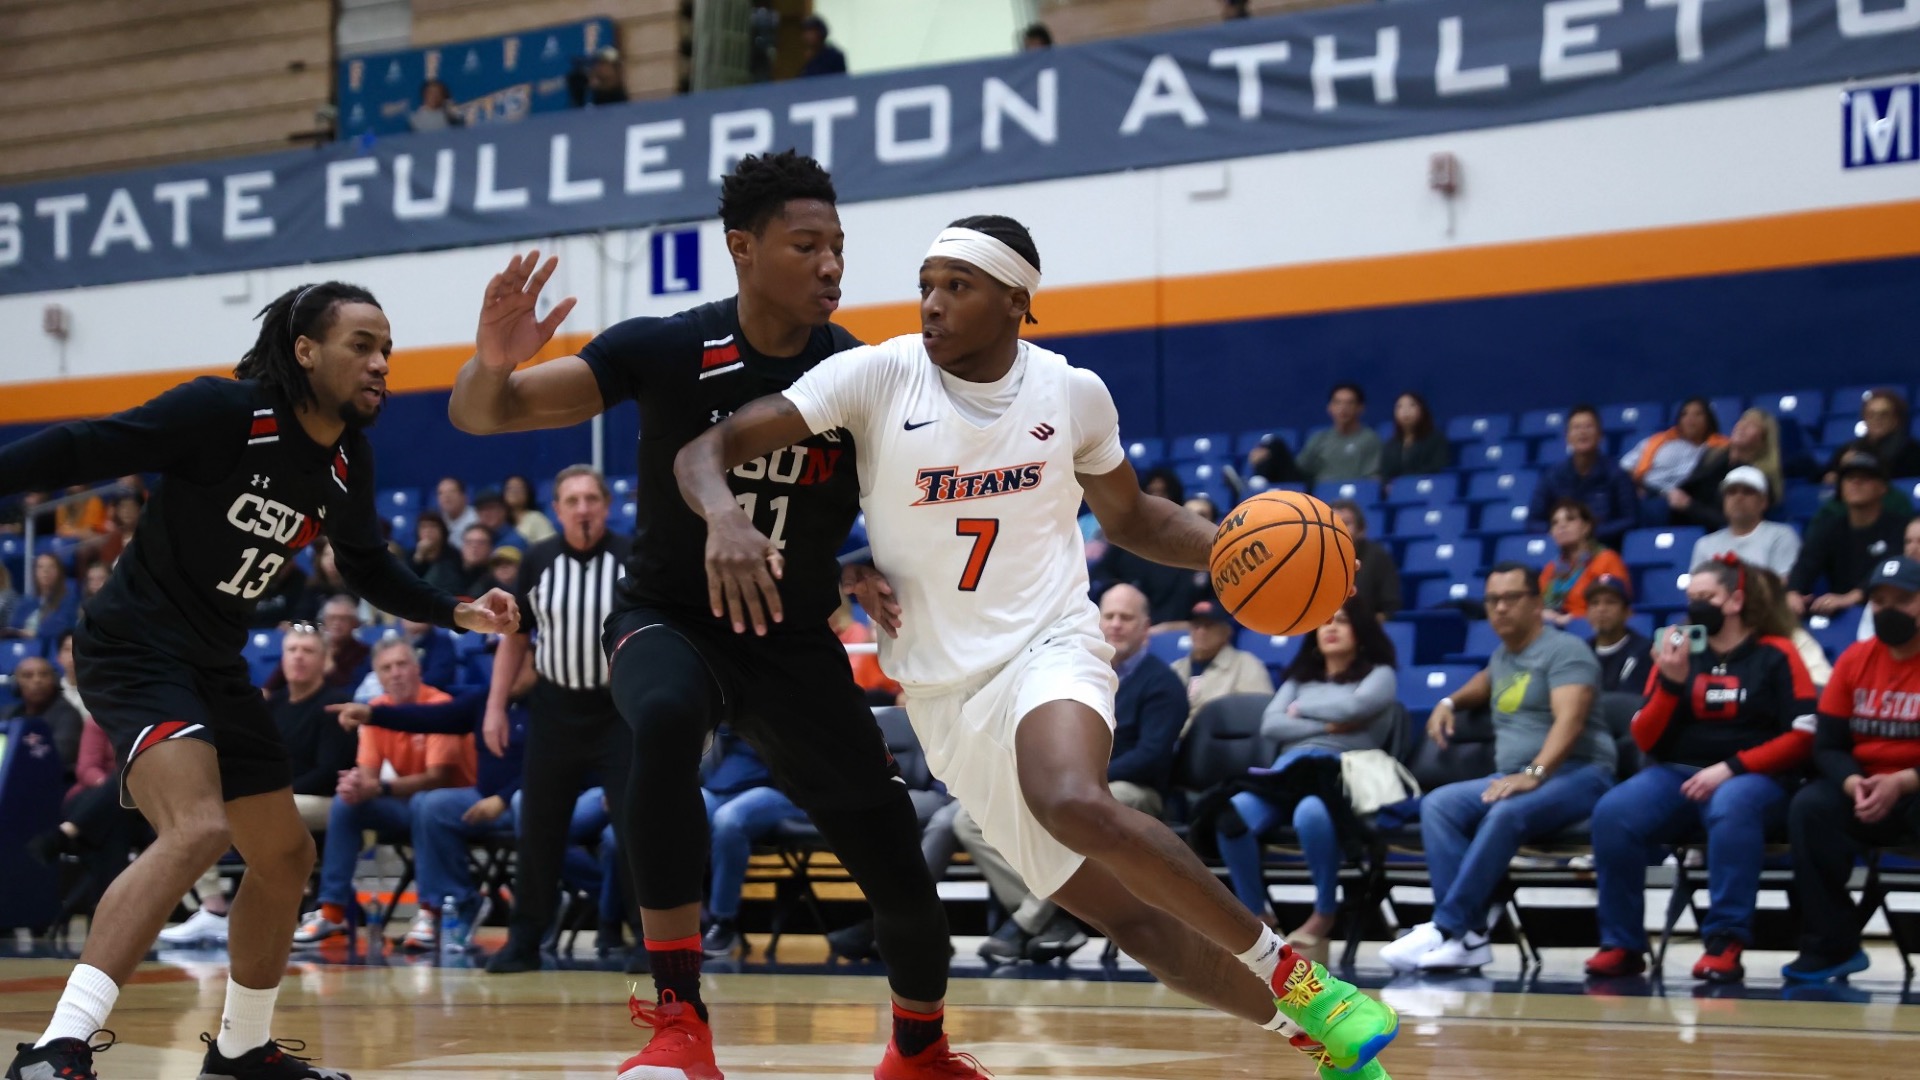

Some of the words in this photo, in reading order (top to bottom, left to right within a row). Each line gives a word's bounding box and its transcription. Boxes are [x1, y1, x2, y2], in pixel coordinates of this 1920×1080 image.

[325, 67, 1058, 228] FULLERTON
[1850, 85, 1913, 164] M
[662, 231, 690, 292] L
[216, 547, 284, 599] 13
[956, 518, 999, 591] 7
